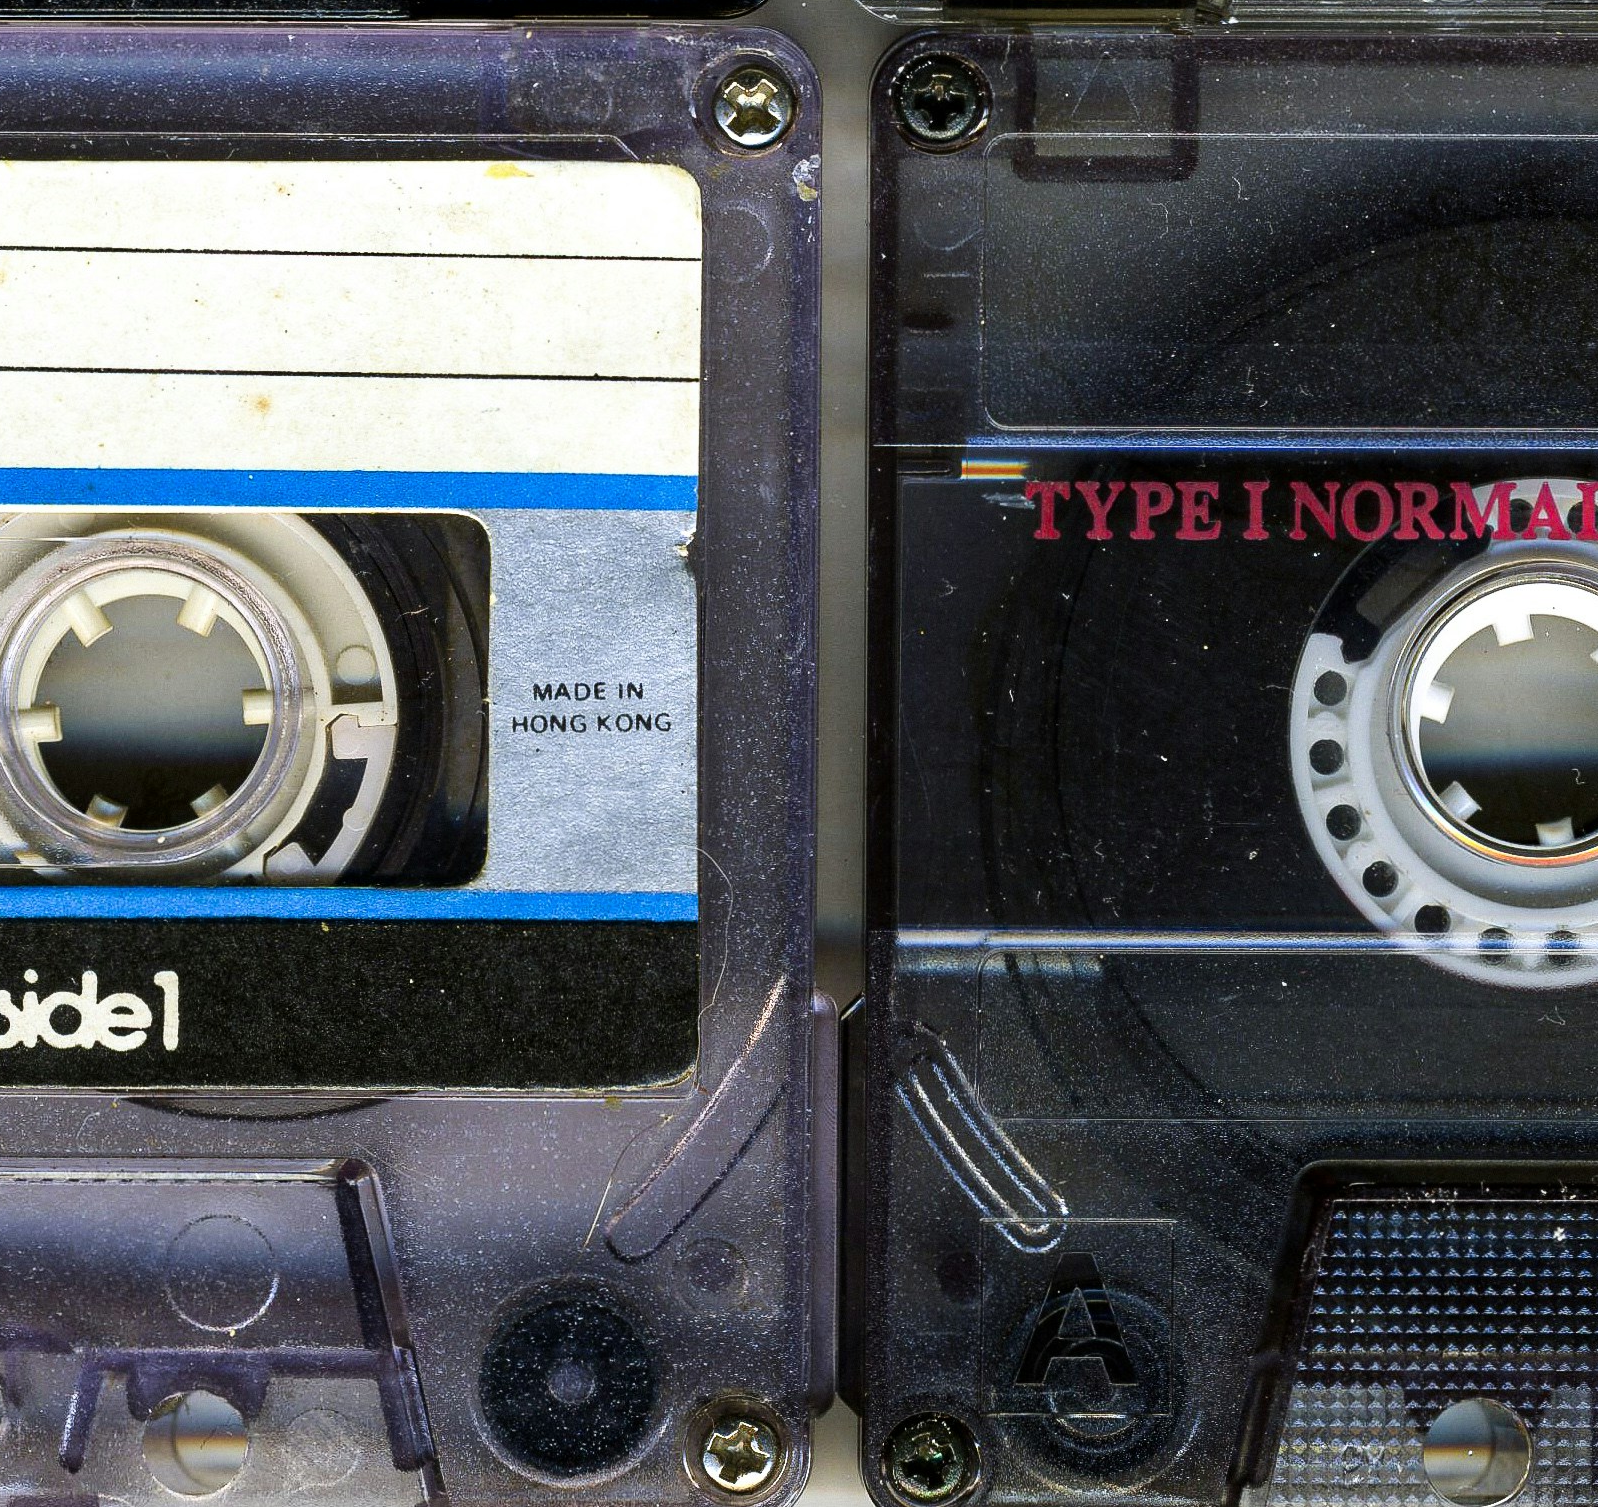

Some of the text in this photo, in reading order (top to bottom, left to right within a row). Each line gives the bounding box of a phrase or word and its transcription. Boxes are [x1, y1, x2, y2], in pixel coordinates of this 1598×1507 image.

[1025, 480, 1221, 541] TYPE
[1243, 480, 1271, 541] I
[532, 682, 644, 701] MADE IN
[512, 713, 672, 733] HONG KONG
